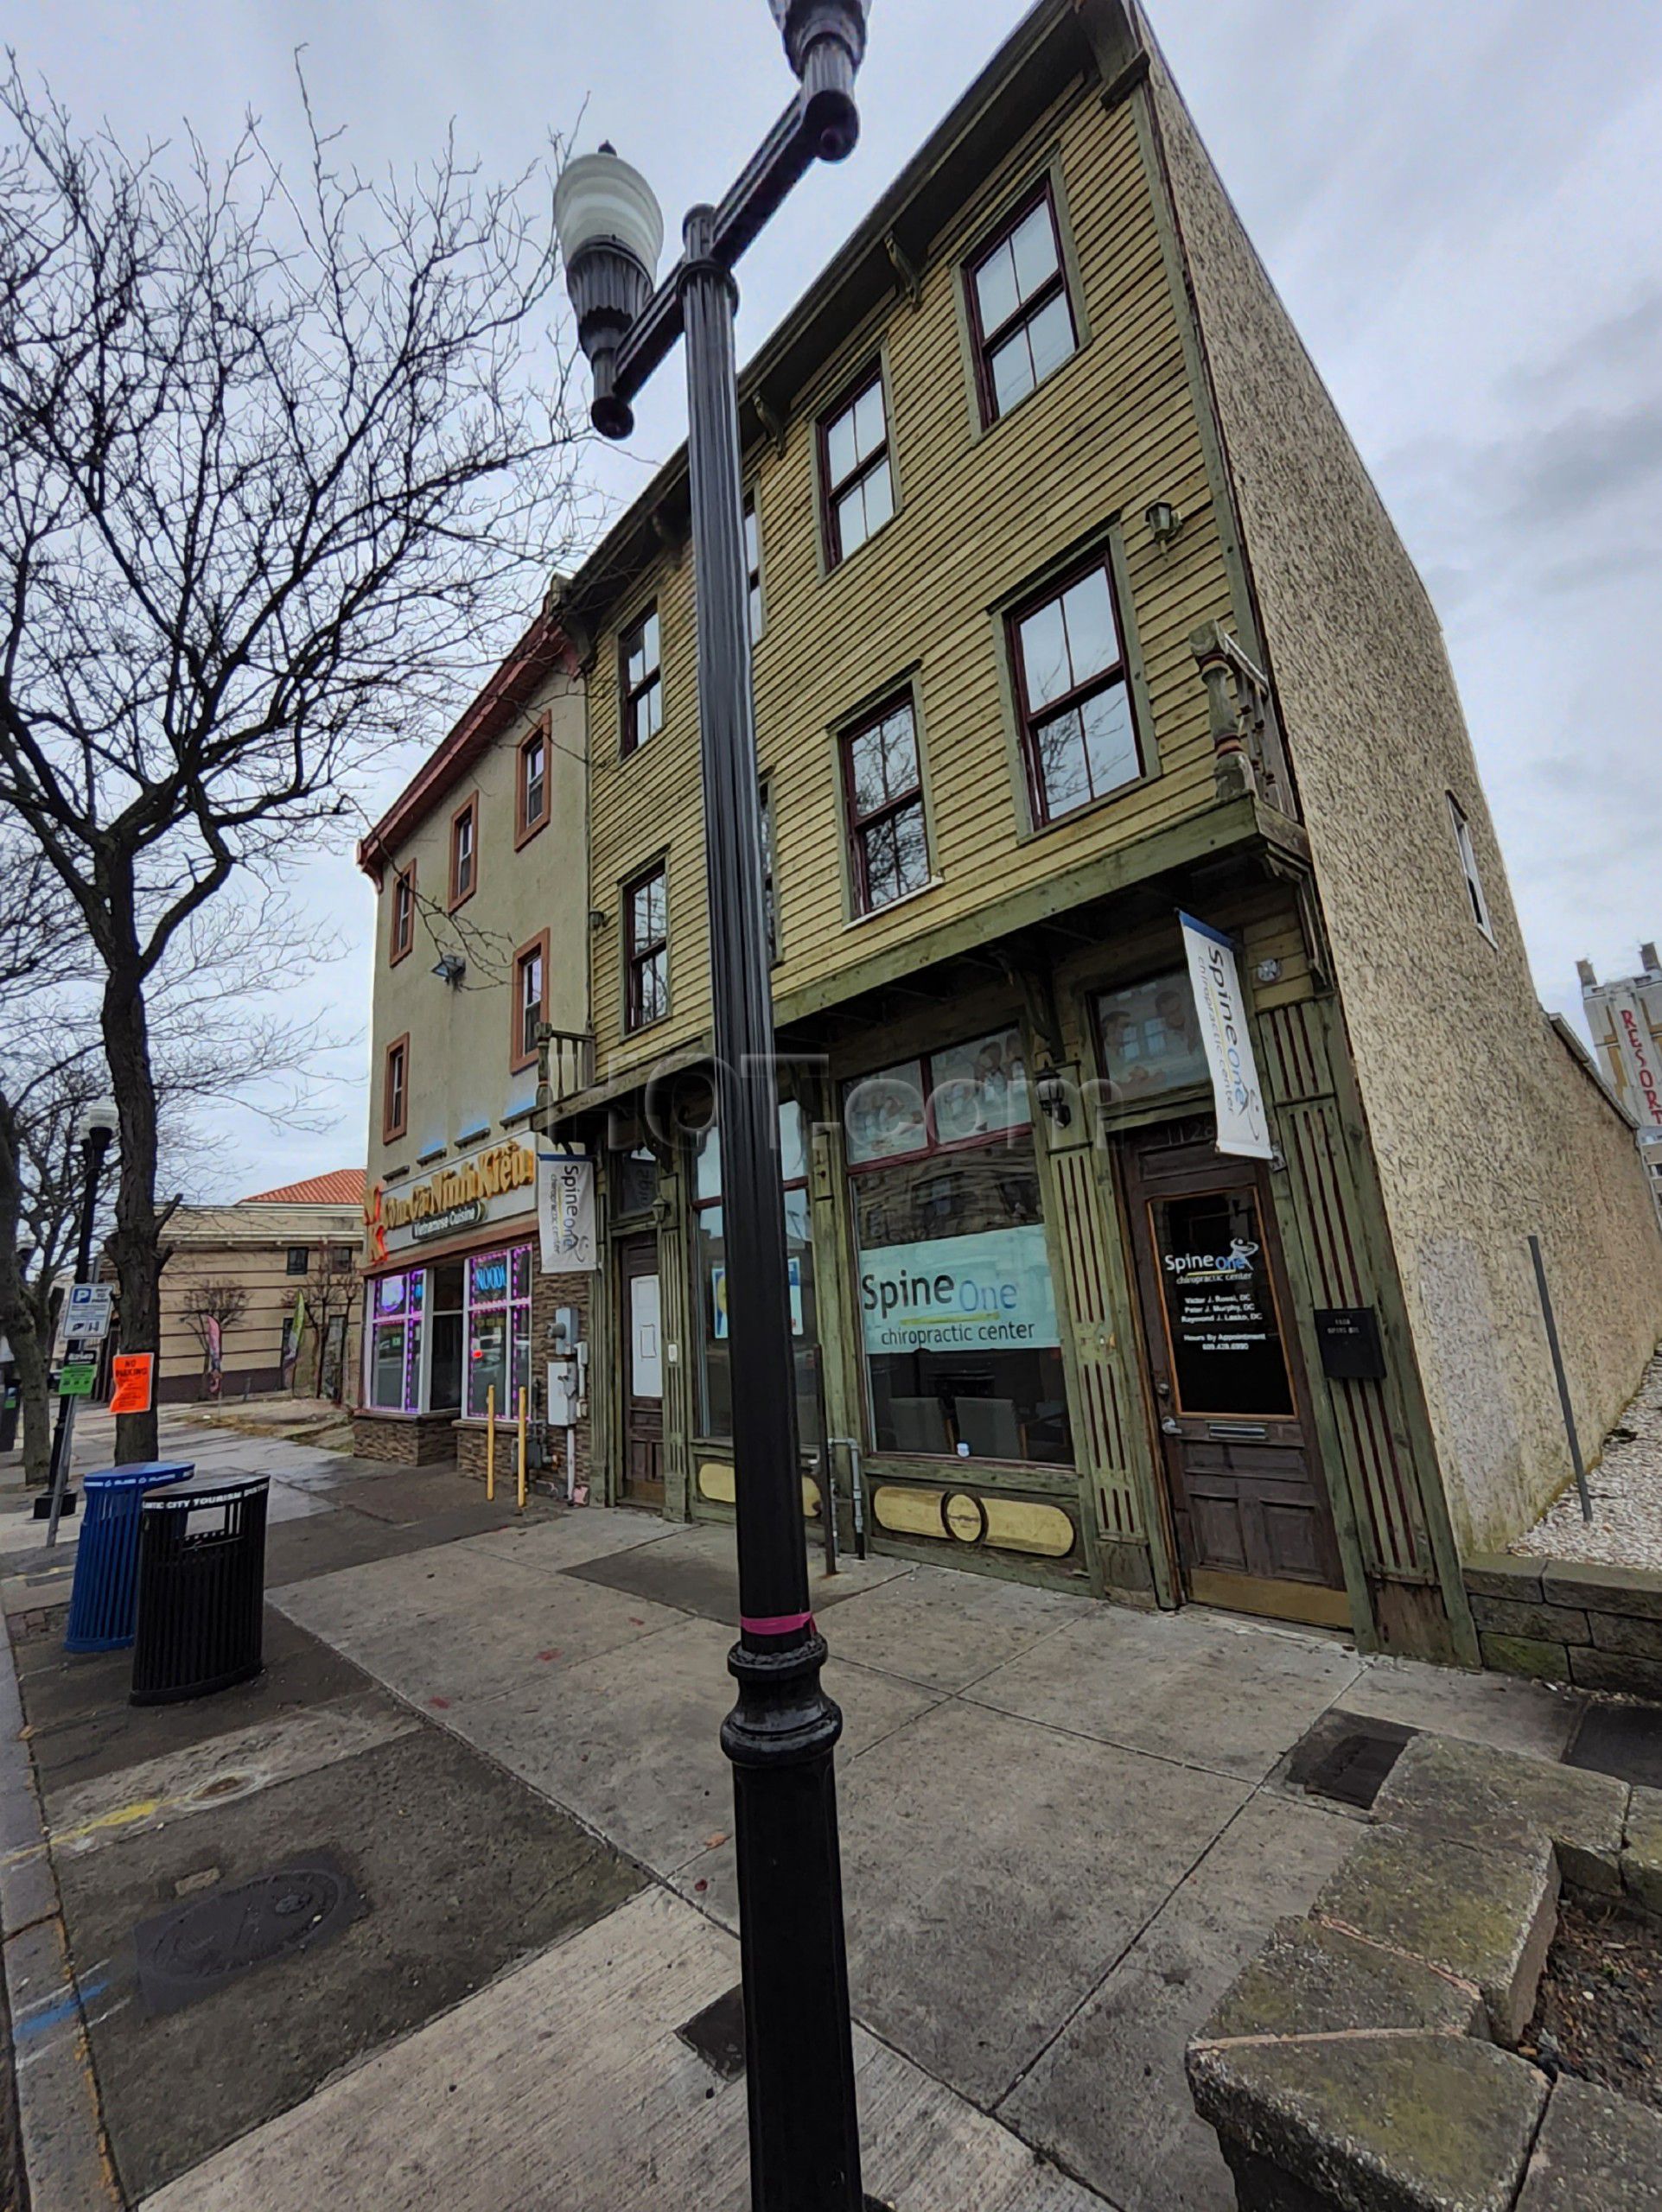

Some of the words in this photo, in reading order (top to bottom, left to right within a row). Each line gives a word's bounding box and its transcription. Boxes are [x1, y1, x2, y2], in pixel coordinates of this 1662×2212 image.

[1208, 945, 1238, 1044] Spine
[1621, 1009, 1662, 1125] RESORT
[560, 1165, 580, 1217] Spine
[1165, 1253, 1213, 1274] Spine
[1225, 1273, 1252, 1281] center
[862, 1269, 954, 1319] Spine
[958, 1280, 1017, 1312] One
[882, 1323, 973, 1347] chiropractic
[977, 1321, 1035, 1339] center
[166, 1500, 190, 1509] CITY
